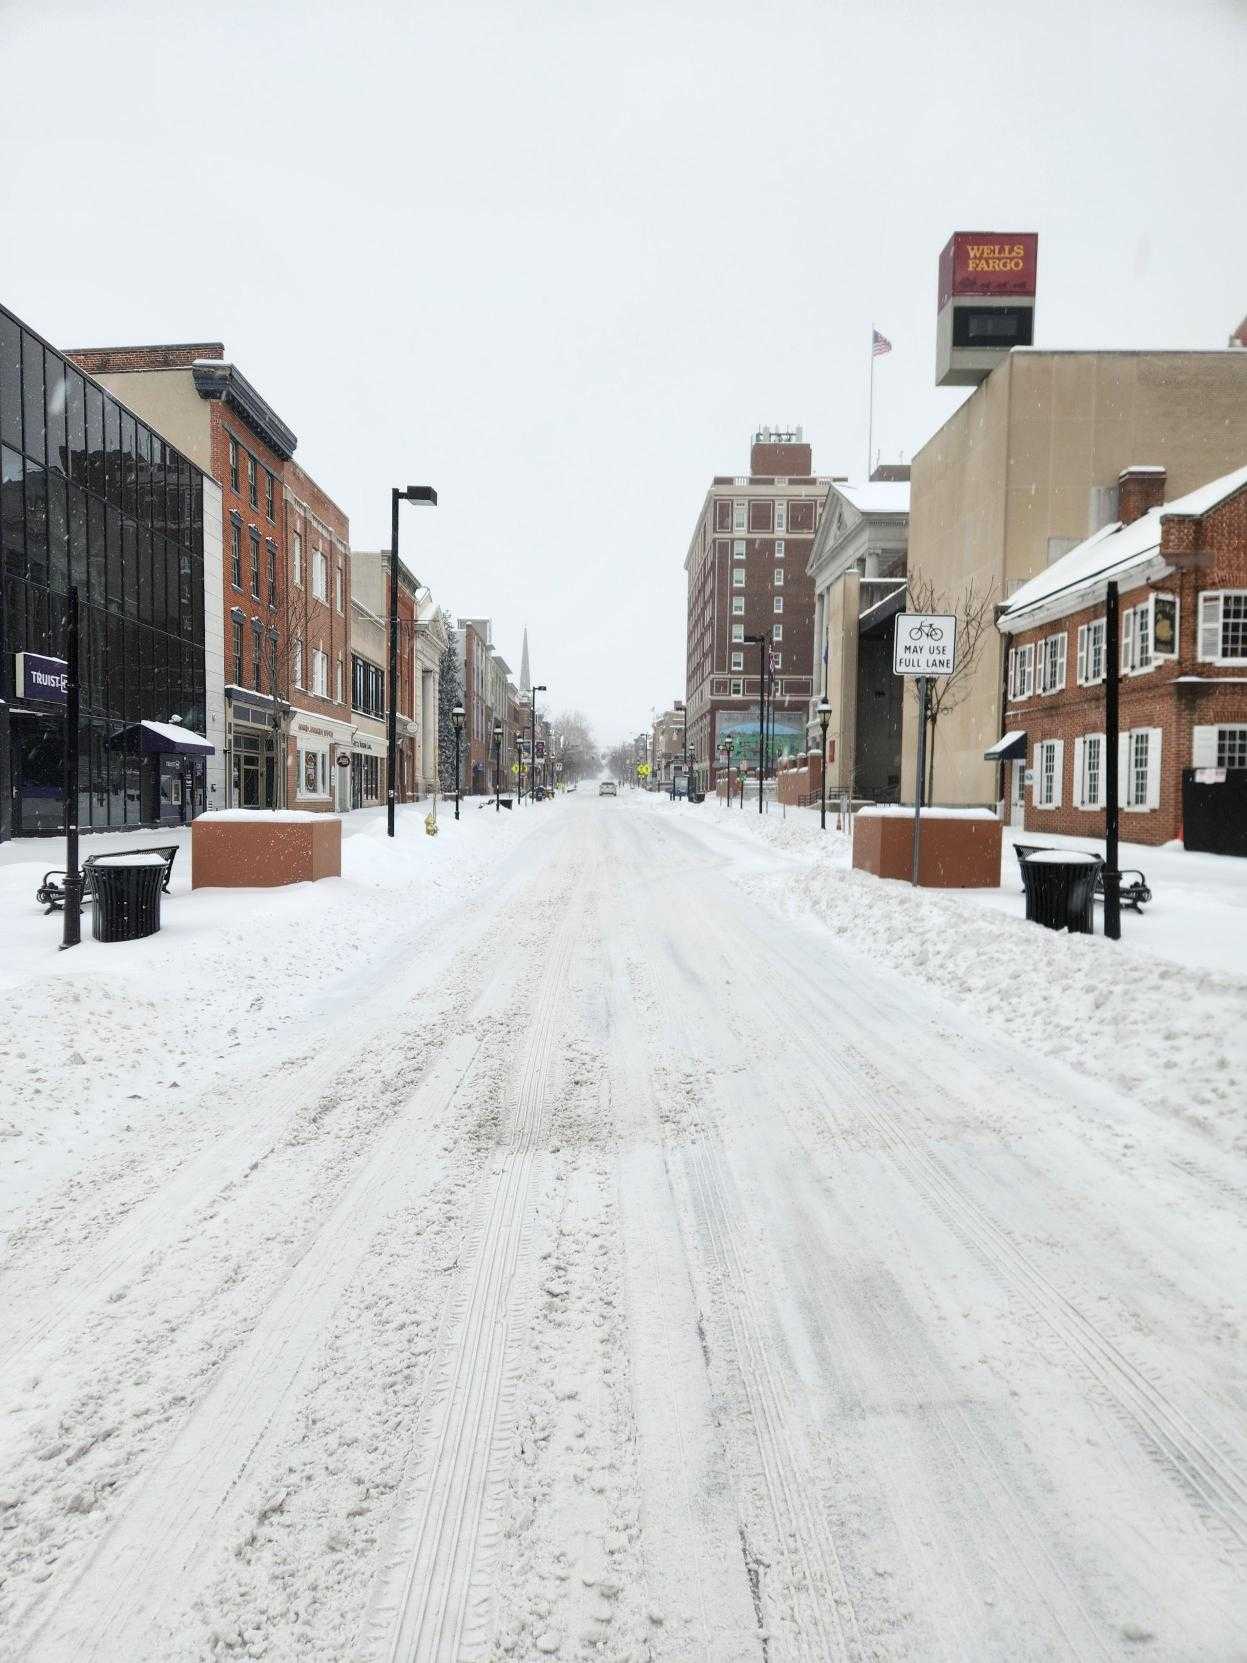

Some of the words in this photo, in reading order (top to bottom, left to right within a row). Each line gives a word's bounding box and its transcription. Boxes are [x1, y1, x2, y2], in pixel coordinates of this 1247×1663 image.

[966, 244, 1024, 258] WELLS
[967, 258, 1024, 271] FARGO
[904, 645, 923, 654] MAY
[929, 645, 947, 655] USE
[899, 658, 921, 667] FULL
[926, 658, 951, 668] LANE
[30, 670, 60, 687] TRUIST
